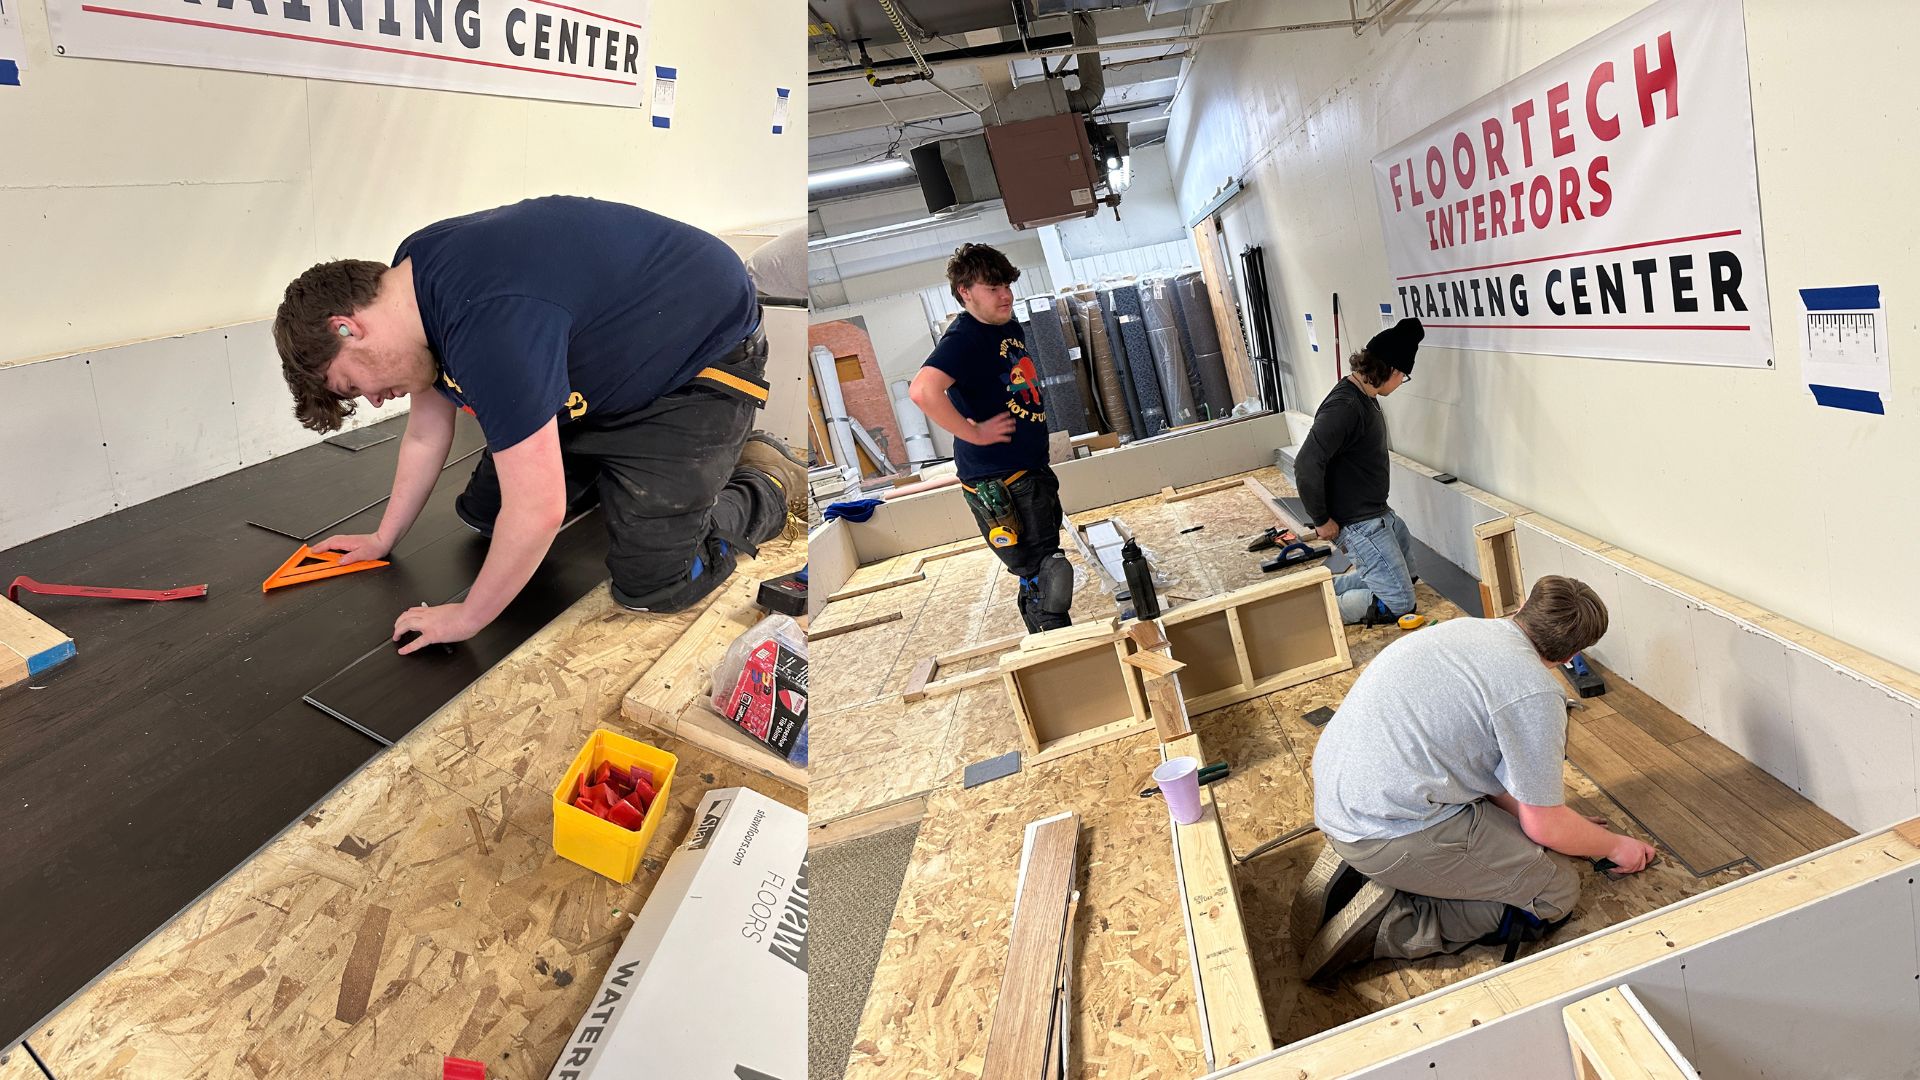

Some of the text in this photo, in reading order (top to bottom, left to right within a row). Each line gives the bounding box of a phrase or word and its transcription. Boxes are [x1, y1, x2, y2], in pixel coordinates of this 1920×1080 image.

[183, 0, 639, 75] NING CENTER
[1389, 30, 1679, 213] FLOORTECH
[1425, 155, 1613, 251] INTERIORS
[1398, 250, 1749, 319] TRAINING CENTER
[1006, 398, 1046, 422] NOT FU
[778, 719, 795, 748] Horseshoe
[733, 809, 765, 866] shawfloors.com
[741, 870, 786, 943] FLOORS
